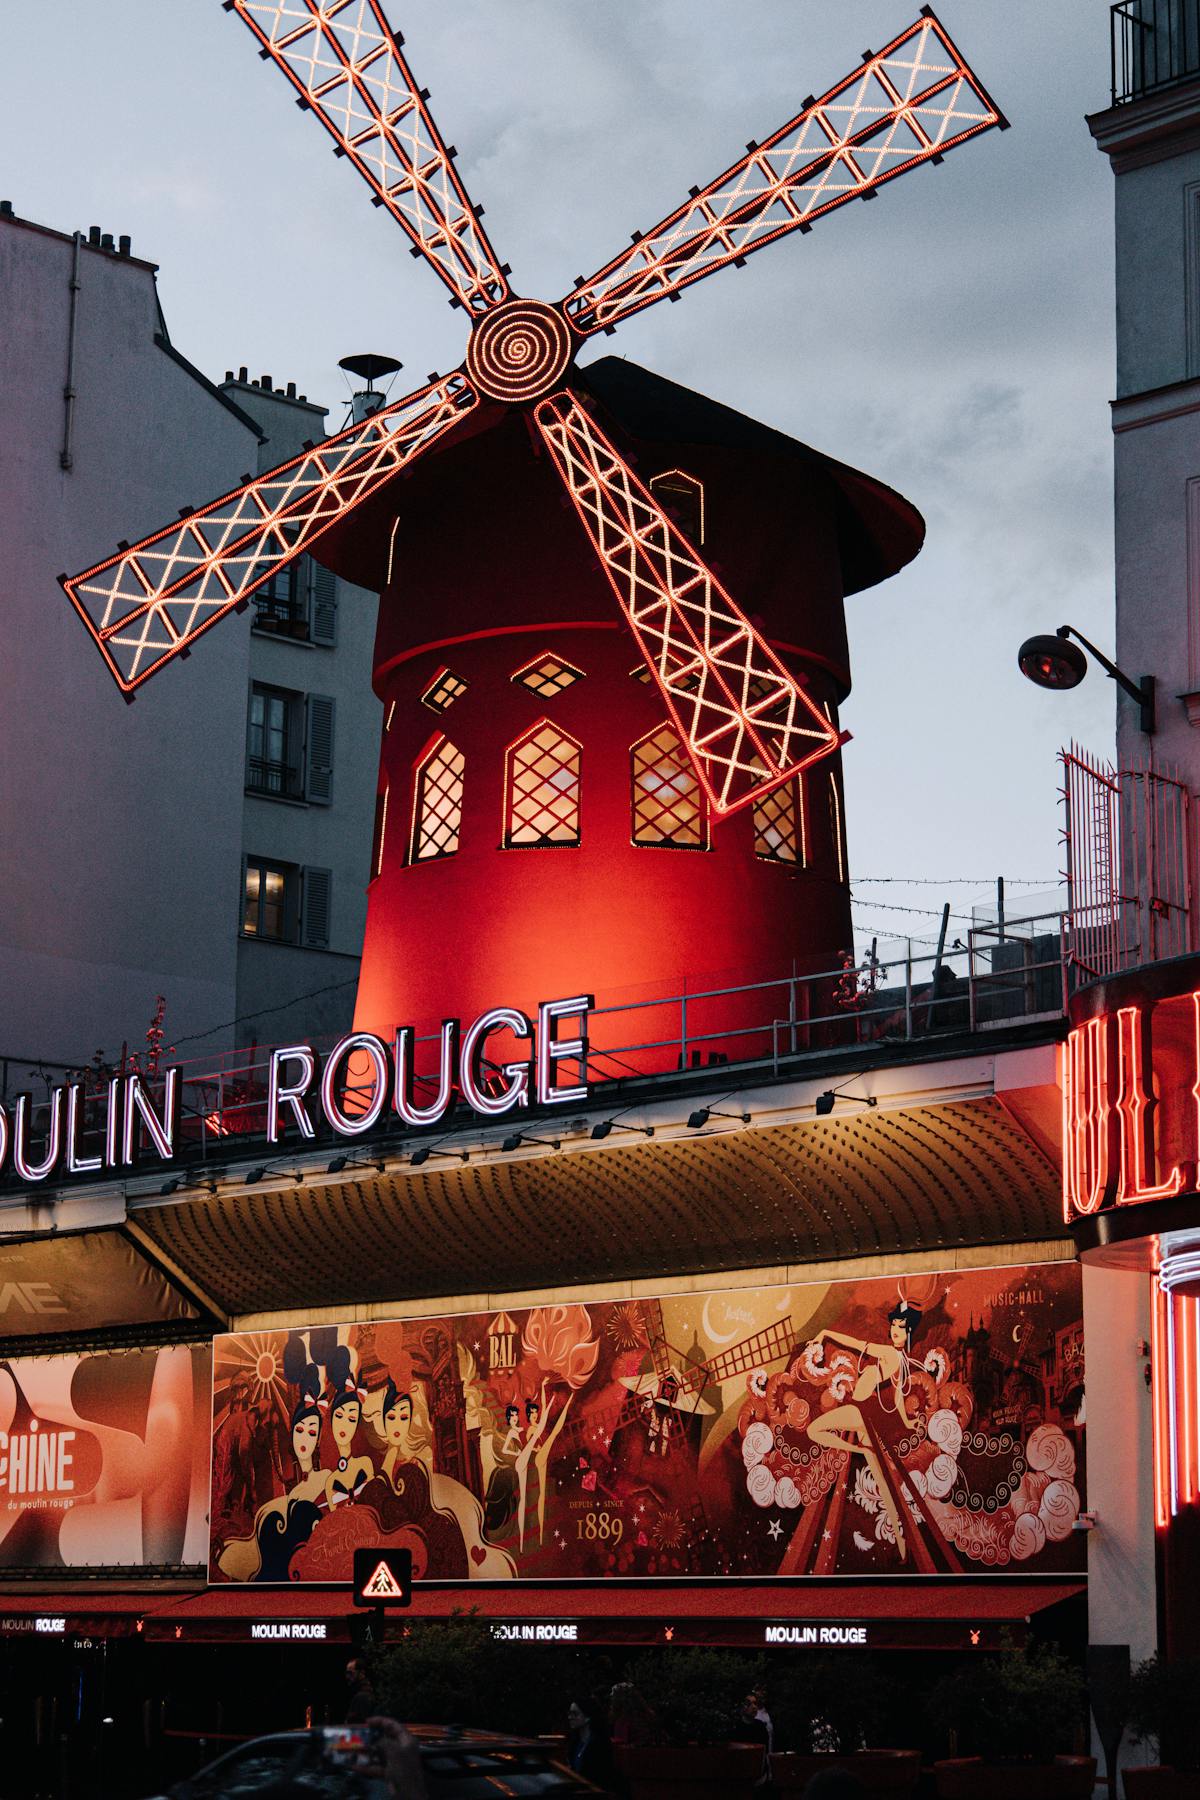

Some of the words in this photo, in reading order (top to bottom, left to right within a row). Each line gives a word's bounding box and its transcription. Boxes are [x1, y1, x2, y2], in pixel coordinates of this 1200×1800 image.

[0, 1067, 180, 1181] ULIN
[267, 995, 593, 1143] ROUGE
[1068, 992, 1200, 1214] UL
[983, 1290, 1045, 1308] MUSIC-HALL
[489, 1335, 517, 1369] BAL
[7, 1499, 17, 1510] du
[20, 1498, 47, 1509] moulin
[49, 1499, 74, 1510] rouge
[569, 1500, 593, 1509] DEPUIS
[603, 1500, 624, 1508] SINCE
[576, 1512, 623, 1546] 1889
[1, 1619, 34, 1631] MOULIN
[35, 1618, 66, 1632] ROUGE
[251, 1624, 290, 1638] MOULIN
[291, 1624, 327, 1638] ROUGE
[536, 1625, 578, 1639] ROUGE
[765, 1626, 817, 1643] MOULIN
[820, 1627, 867, 1643] ROUGE
